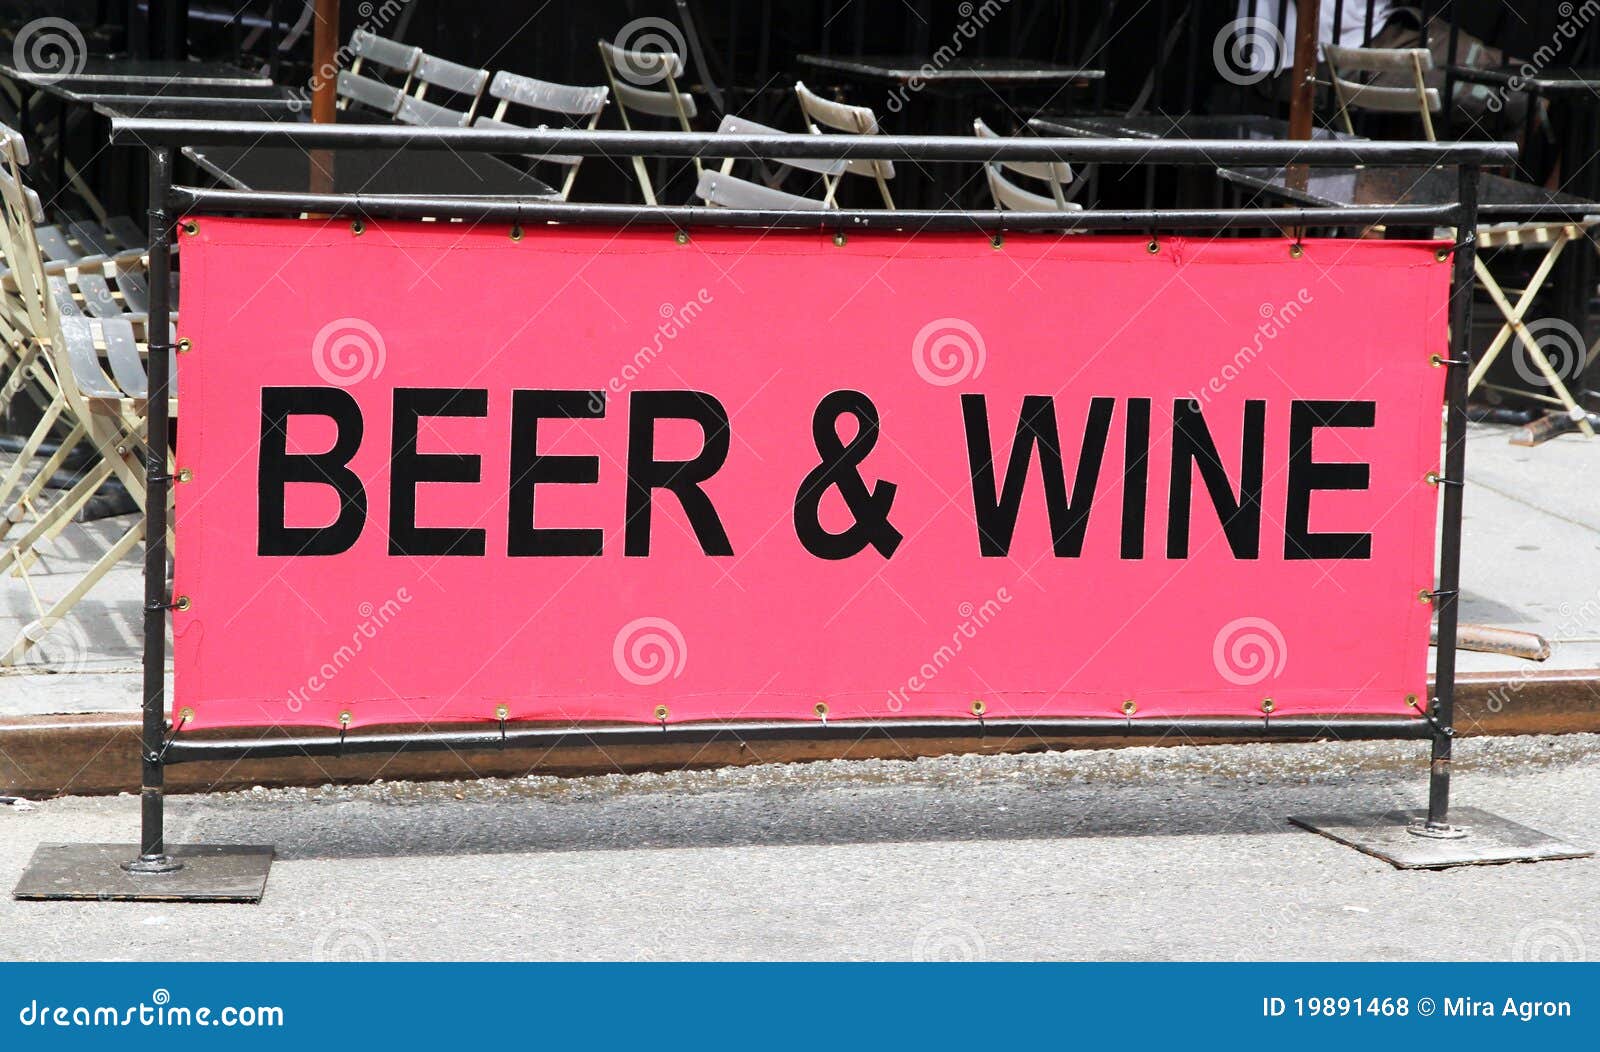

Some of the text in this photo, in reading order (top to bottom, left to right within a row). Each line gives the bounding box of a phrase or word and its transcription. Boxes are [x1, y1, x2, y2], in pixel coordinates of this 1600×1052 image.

[256, 386, 1377, 561] BEER & WINE
